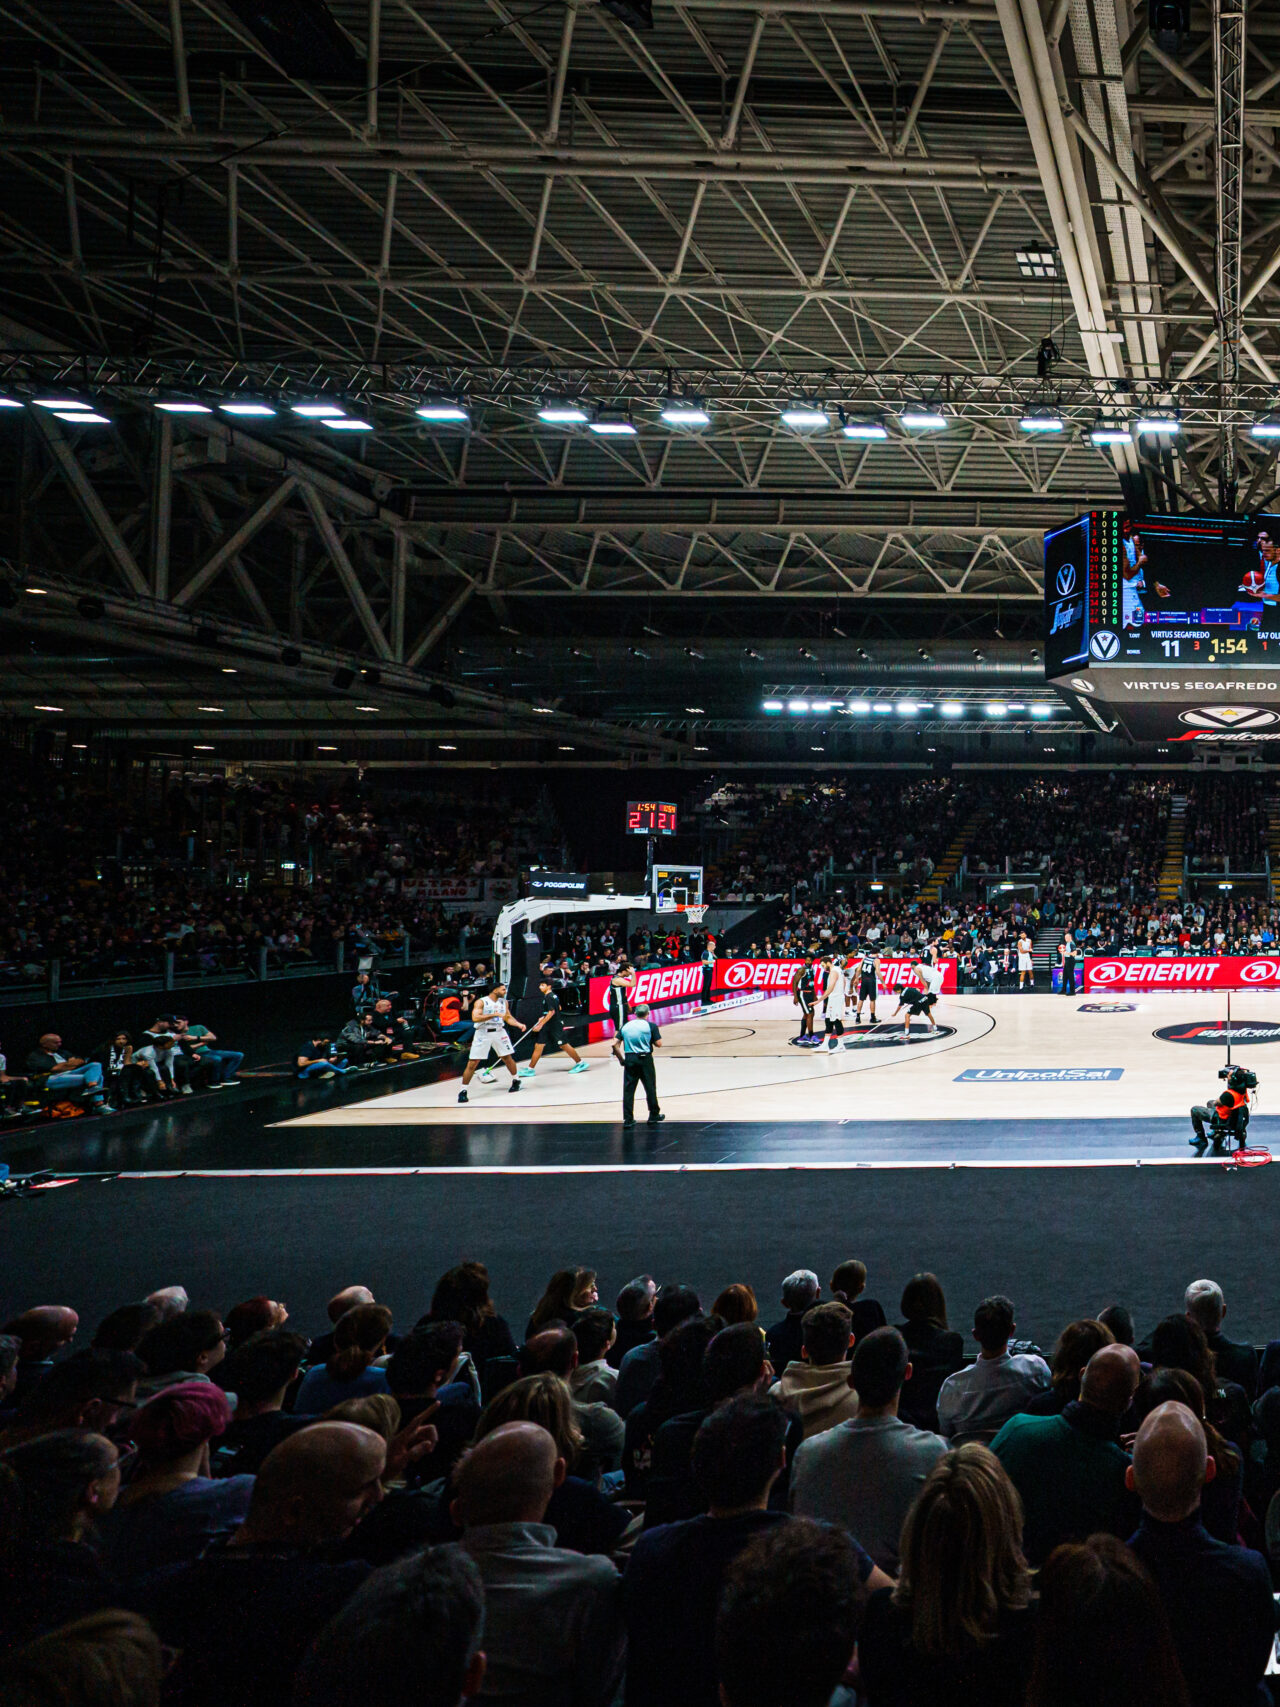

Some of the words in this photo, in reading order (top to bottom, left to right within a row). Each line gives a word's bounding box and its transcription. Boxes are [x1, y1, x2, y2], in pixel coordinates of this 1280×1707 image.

[1174, 631, 1210, 639] SEGAFREDO
[1161, 640, 1180, 657] 11
[1193, 640, 1200, 650] 3
[1211, 638, 1248, 654] 1:54
[1262, 642, 1267, 650] 1
[1124, 682, 1180, 690] VIRTUS
[1185, 682, 1277, 690] SEGAFREDO
[638, 803, 656, 811] 1:54
[629, 812, 655, 828] 21
[658, 813, 676, 830] 21
[404, 880, 478, 888] ULTRAS
[417, 888, 468, 896] MILANO
[862, 964, 872, 973] 44
[1124, 963, 1220, 981] ENERVIT
[634, 965, 703, 1004] ENERVIT
